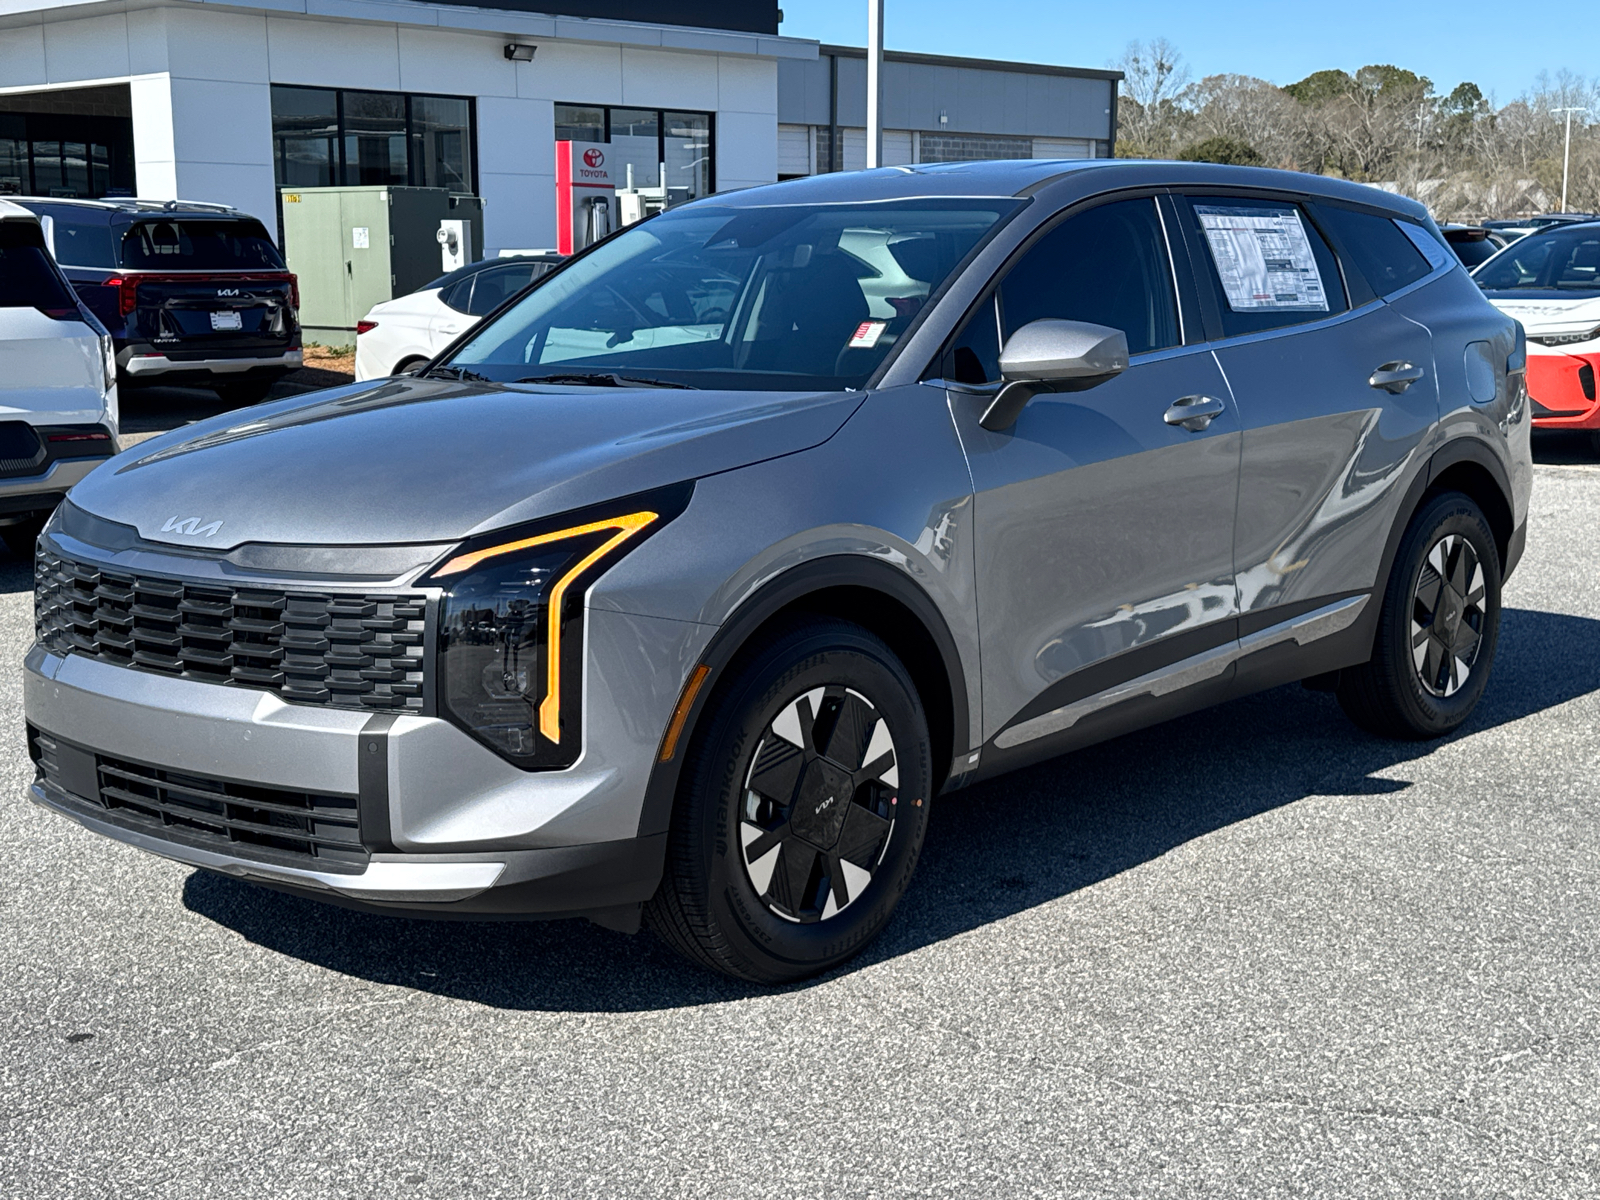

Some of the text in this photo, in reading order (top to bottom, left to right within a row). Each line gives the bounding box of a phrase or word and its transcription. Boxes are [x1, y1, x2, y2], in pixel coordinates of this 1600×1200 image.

[579, 169, 609, 178] TOYOTA
[217, 288, 240, 296] KIA
[160, 514, 224, 538] KIA
